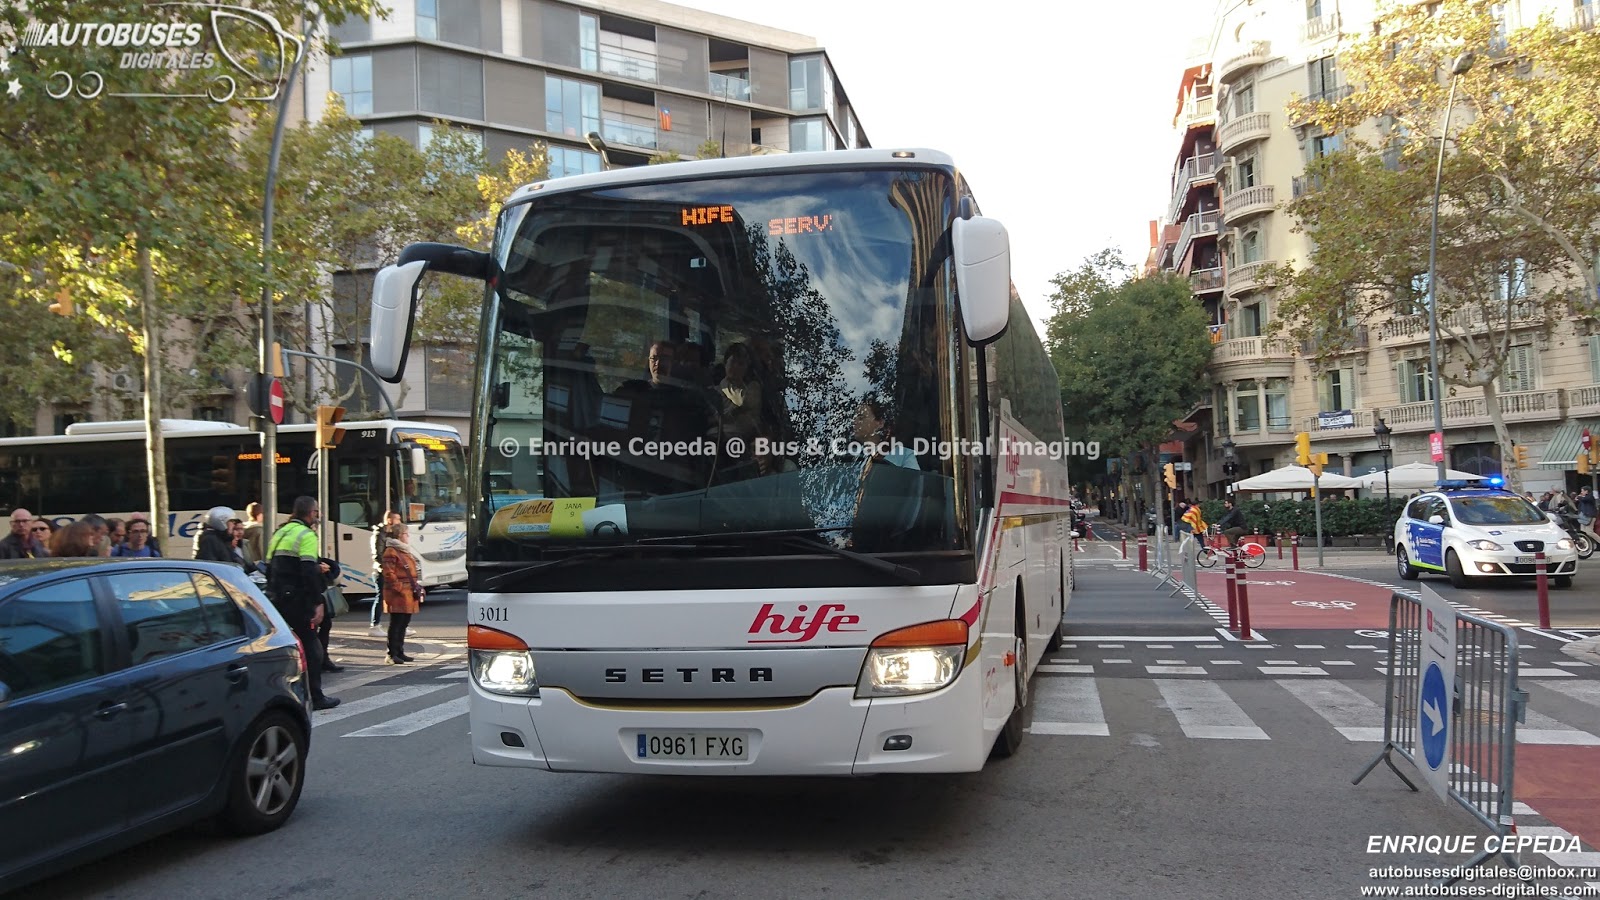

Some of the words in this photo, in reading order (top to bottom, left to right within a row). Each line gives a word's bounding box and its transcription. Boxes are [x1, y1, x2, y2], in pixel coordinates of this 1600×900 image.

[682, 205, 734, 226] HIFE
[361, 430, 377, 438] 913
[479, 607, 509, 622] 3011
[748, 603, 868, 644] hife
[605, 667, 774, 683] SETRA
[650, 736, 696, 756] 0961
[706, 737, 743, 756] FXG
